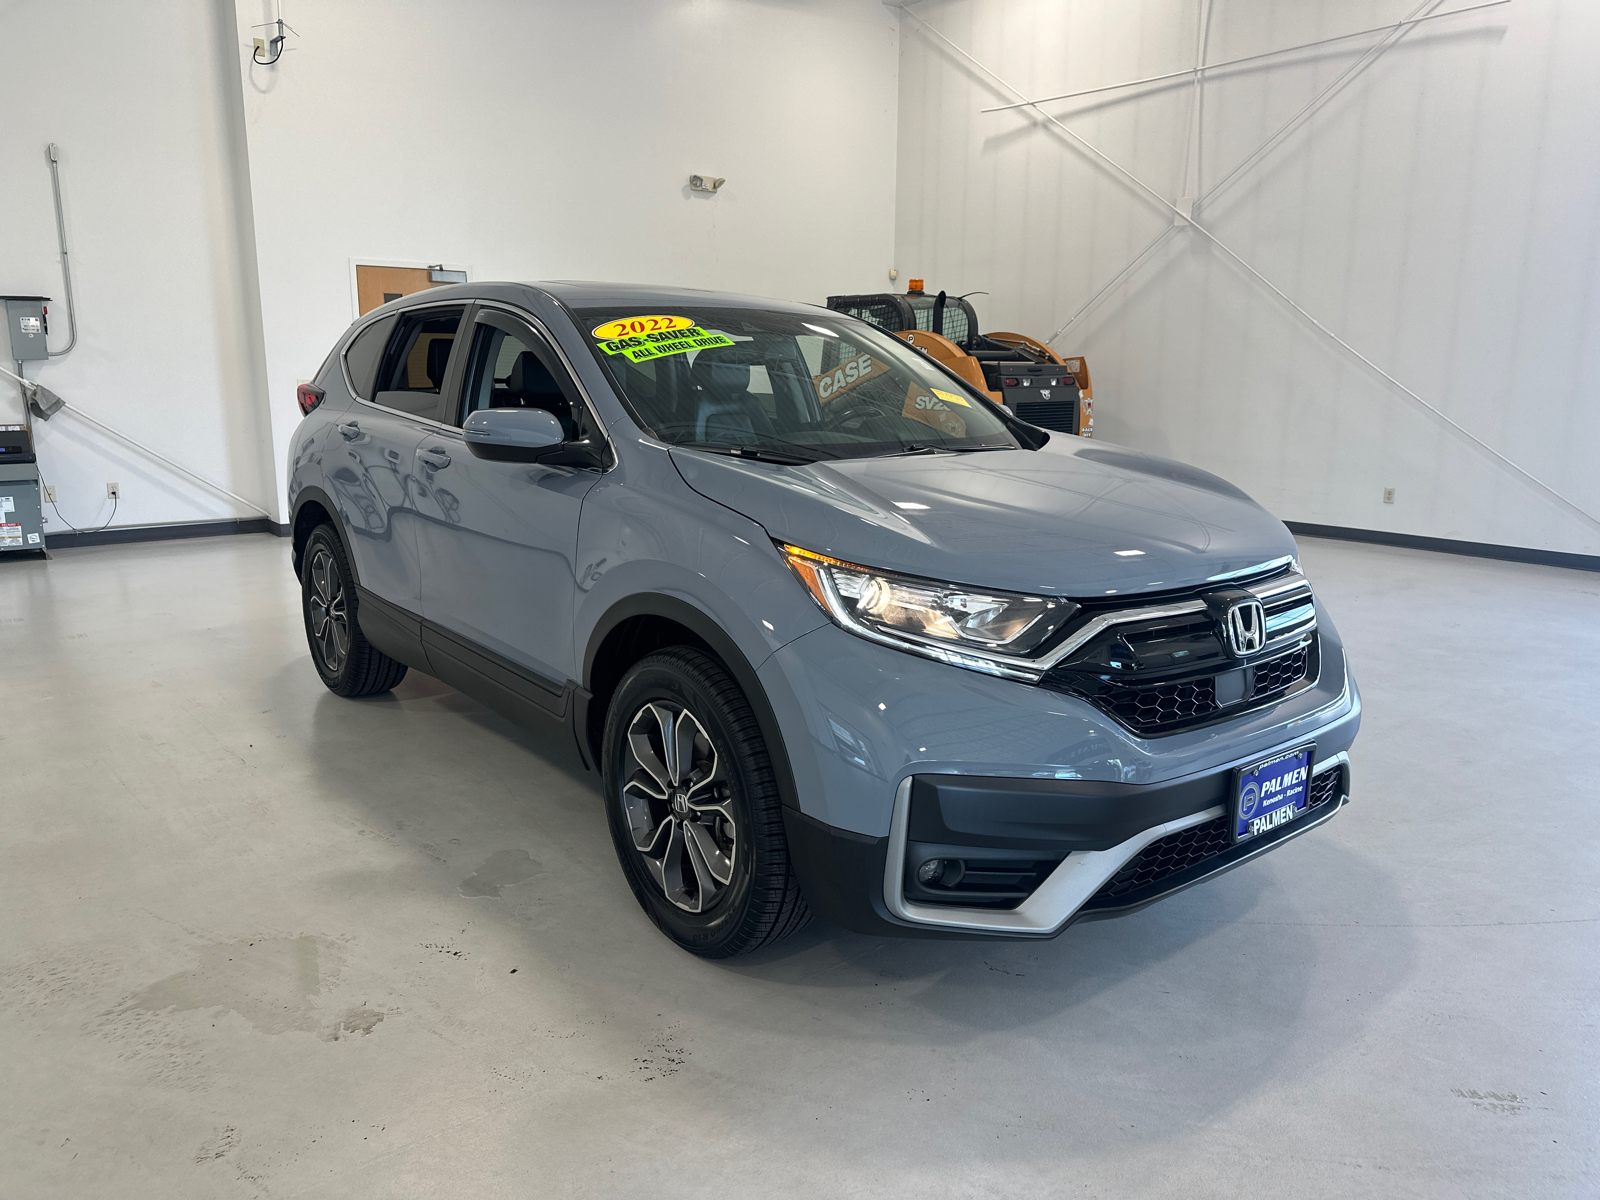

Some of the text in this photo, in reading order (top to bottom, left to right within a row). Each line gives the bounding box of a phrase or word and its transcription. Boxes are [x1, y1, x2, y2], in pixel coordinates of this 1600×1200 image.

[613, 317, 677, 338] 2022
[605, 328, 701, 352] GAS-SAVER
[631, 336, 727, 360] ALL WHEEL DRIVE
[818, 353, 872, 399] CASE
[1260, 765, 1309, 798] PALMEN
[1262, 794, 1284, 807] Kenosha
[1286, 785, 1304, 797] Racine
[1253, 804, 1293, 836] PALMEN
